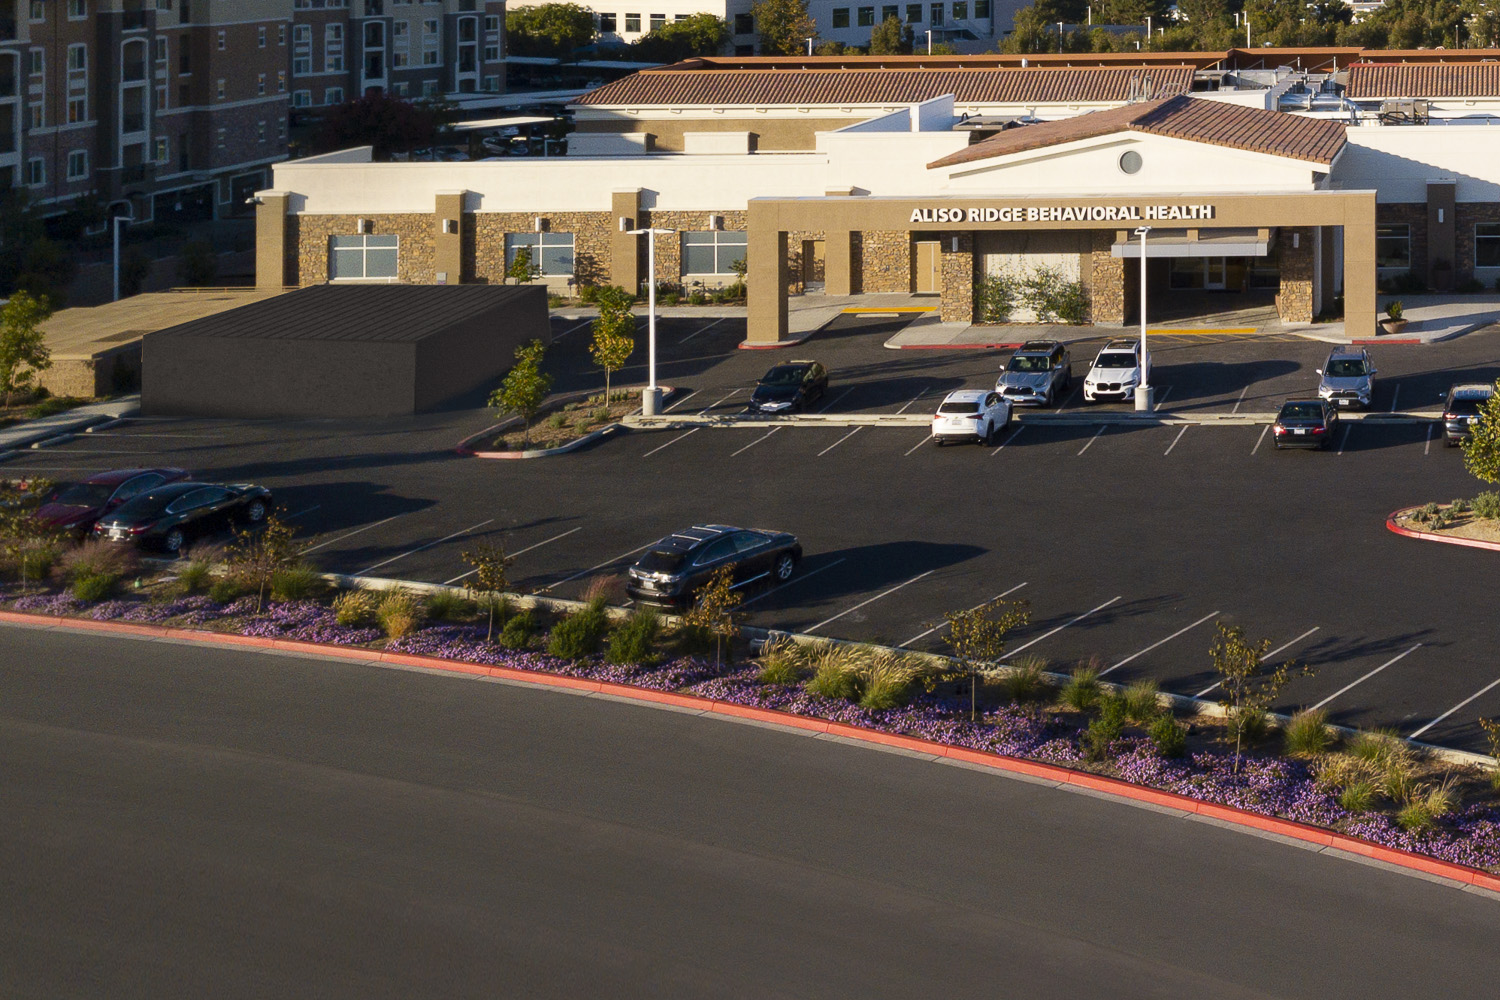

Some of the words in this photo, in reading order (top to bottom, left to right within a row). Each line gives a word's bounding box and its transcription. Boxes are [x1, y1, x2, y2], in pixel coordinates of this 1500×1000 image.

[909, 208, 964, 223] ALISO
[967, 207, 1023, 222] RIDGE
[1027, 206, 1140, 221] BEHAVIORAL
[1145, 205, 1213, 220] HEALTH
